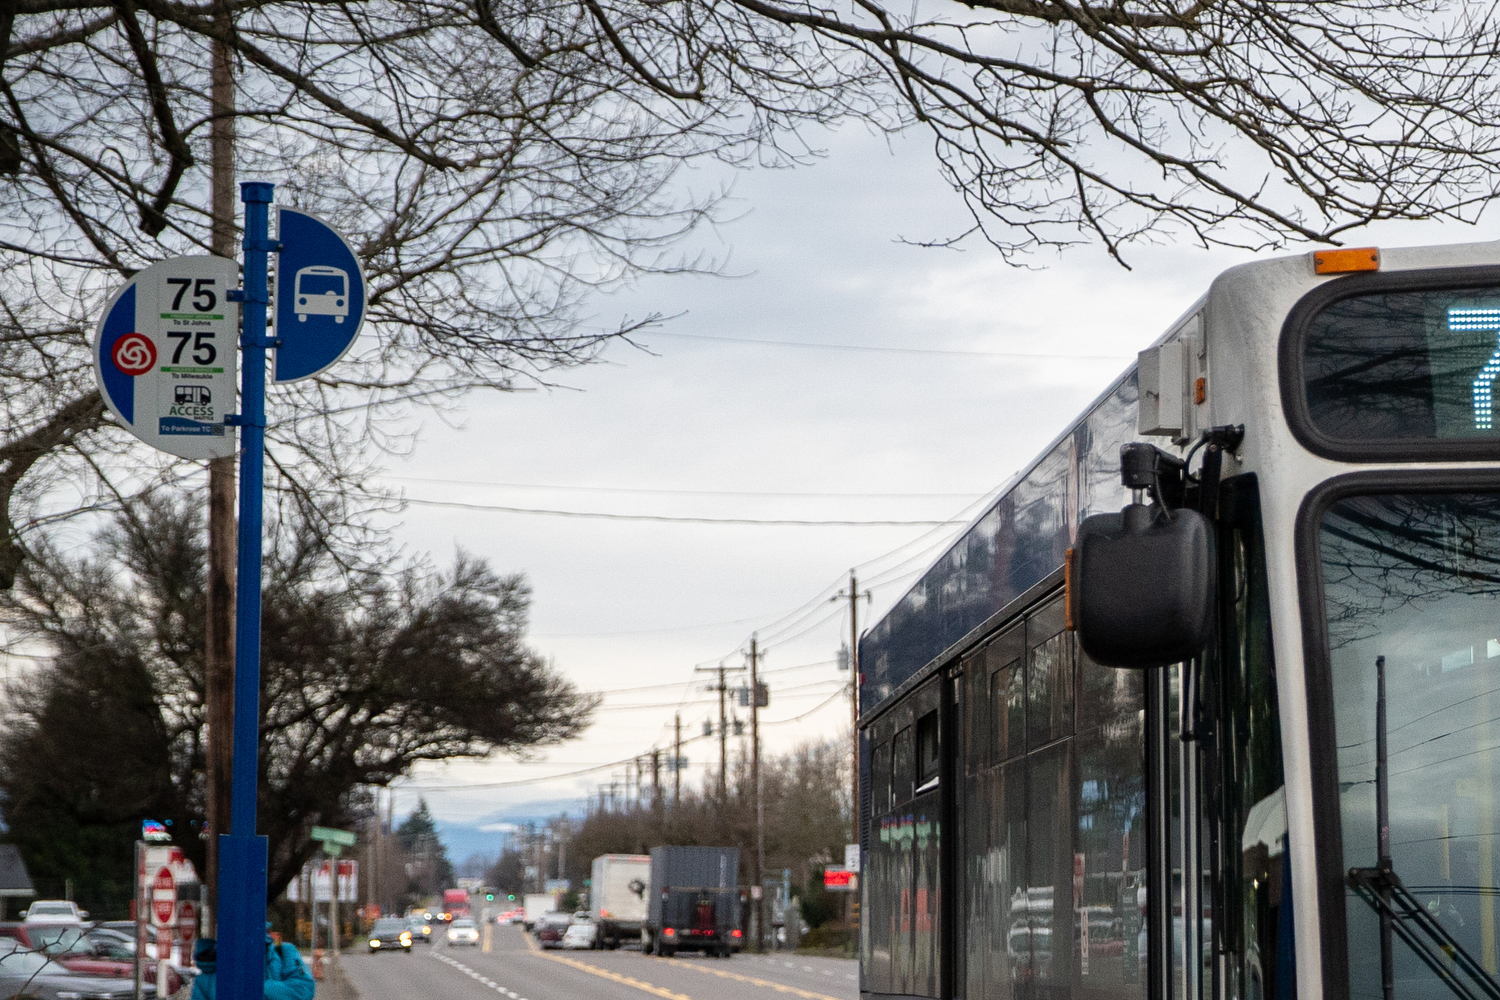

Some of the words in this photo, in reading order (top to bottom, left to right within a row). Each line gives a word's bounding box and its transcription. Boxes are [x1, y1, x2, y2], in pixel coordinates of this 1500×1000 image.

[167, 277, 217, 312] 75
[167, 331, 217, 366] 75
[169, 406, 214, 416] ACCESS
